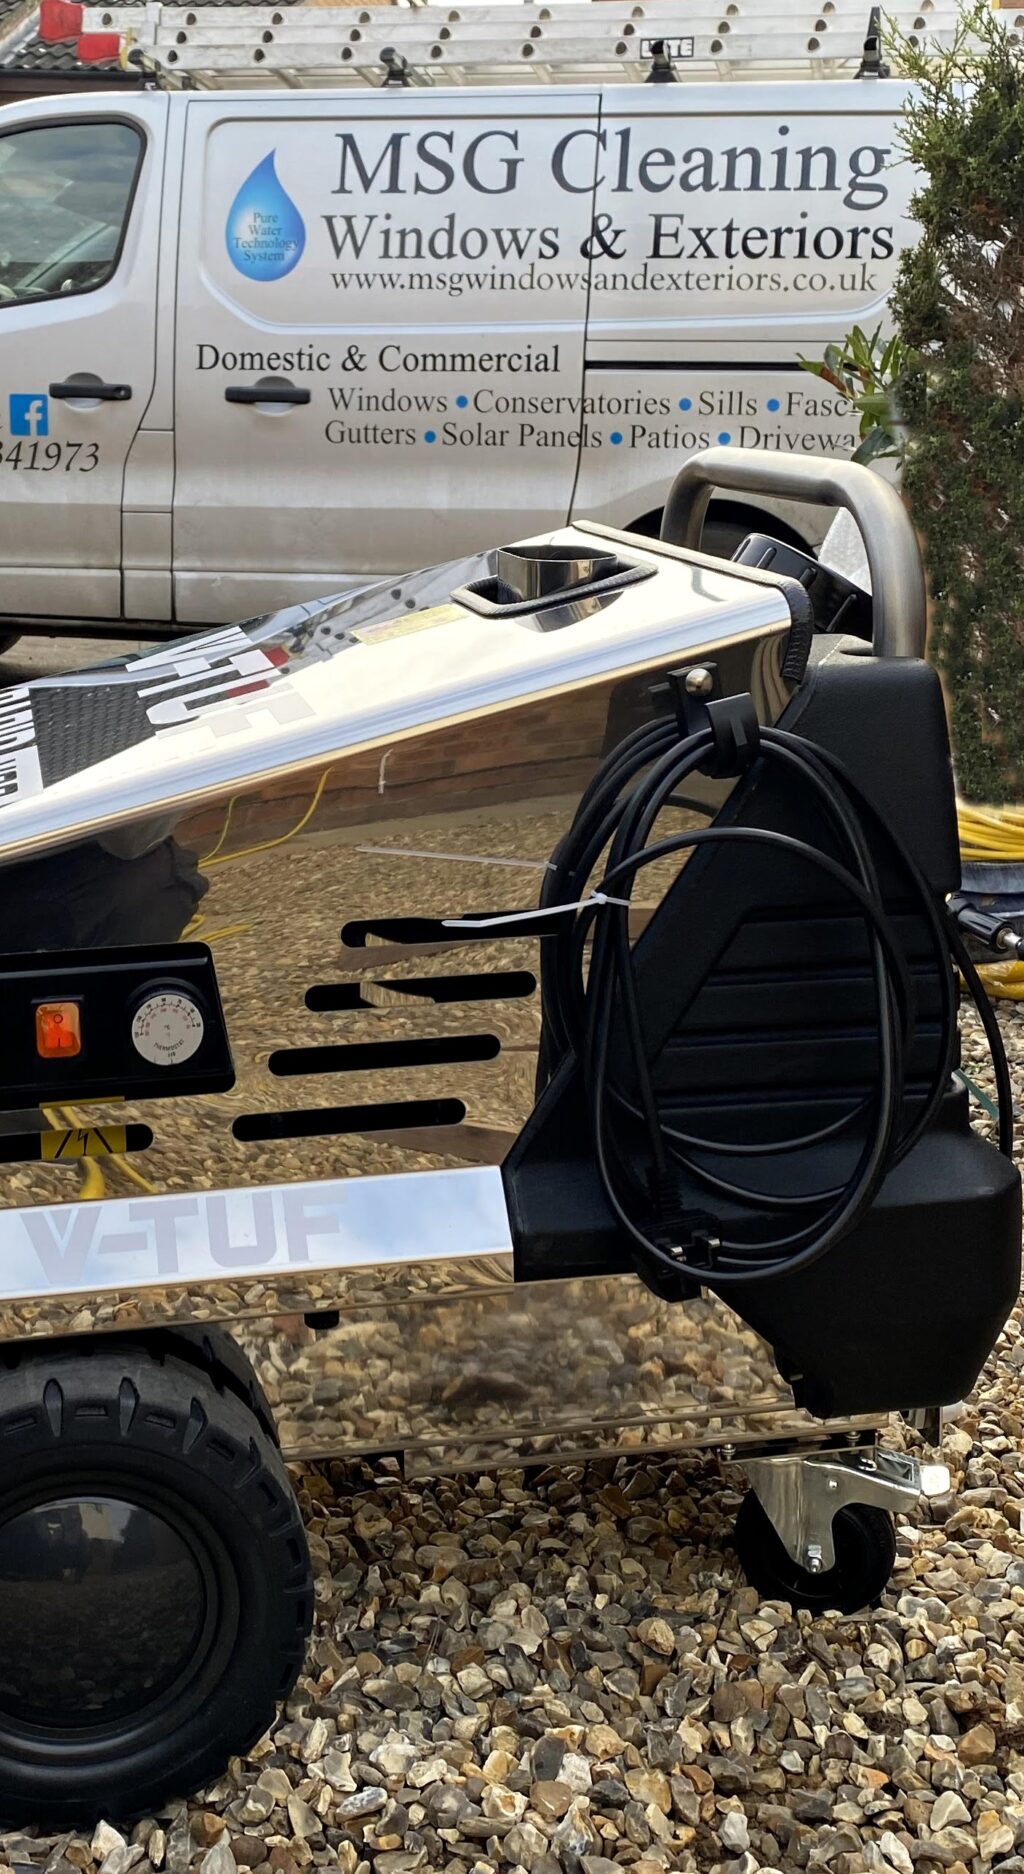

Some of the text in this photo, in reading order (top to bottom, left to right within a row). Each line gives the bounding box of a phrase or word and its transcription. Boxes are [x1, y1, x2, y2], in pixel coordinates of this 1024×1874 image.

[641, 39, 693, 57] LTE
[331, 125, 891, 211] MSG Cleaning
[248, 224, 283, 236] Water
[253, 212, 279, 224] Pure
[233, 237, 298, 252] Technology
[320, 211, 894, 260] Windows & Exteriors
[243, 250, 285, 264] System
[331, 262, 878, 297] www.msgwindowsandexteriors.co.uk
[195, 344, 561, 373] Domestic & Commercial
[327, 386, 857, 417] Windows Conservatories Sills Fasc
[325, 420, 856, 451] Gutters Solar Panels Patios Drivewa
[125, 626, 317, 739] V-TUF
[19, 1183, 348, 1285] V-TUF
